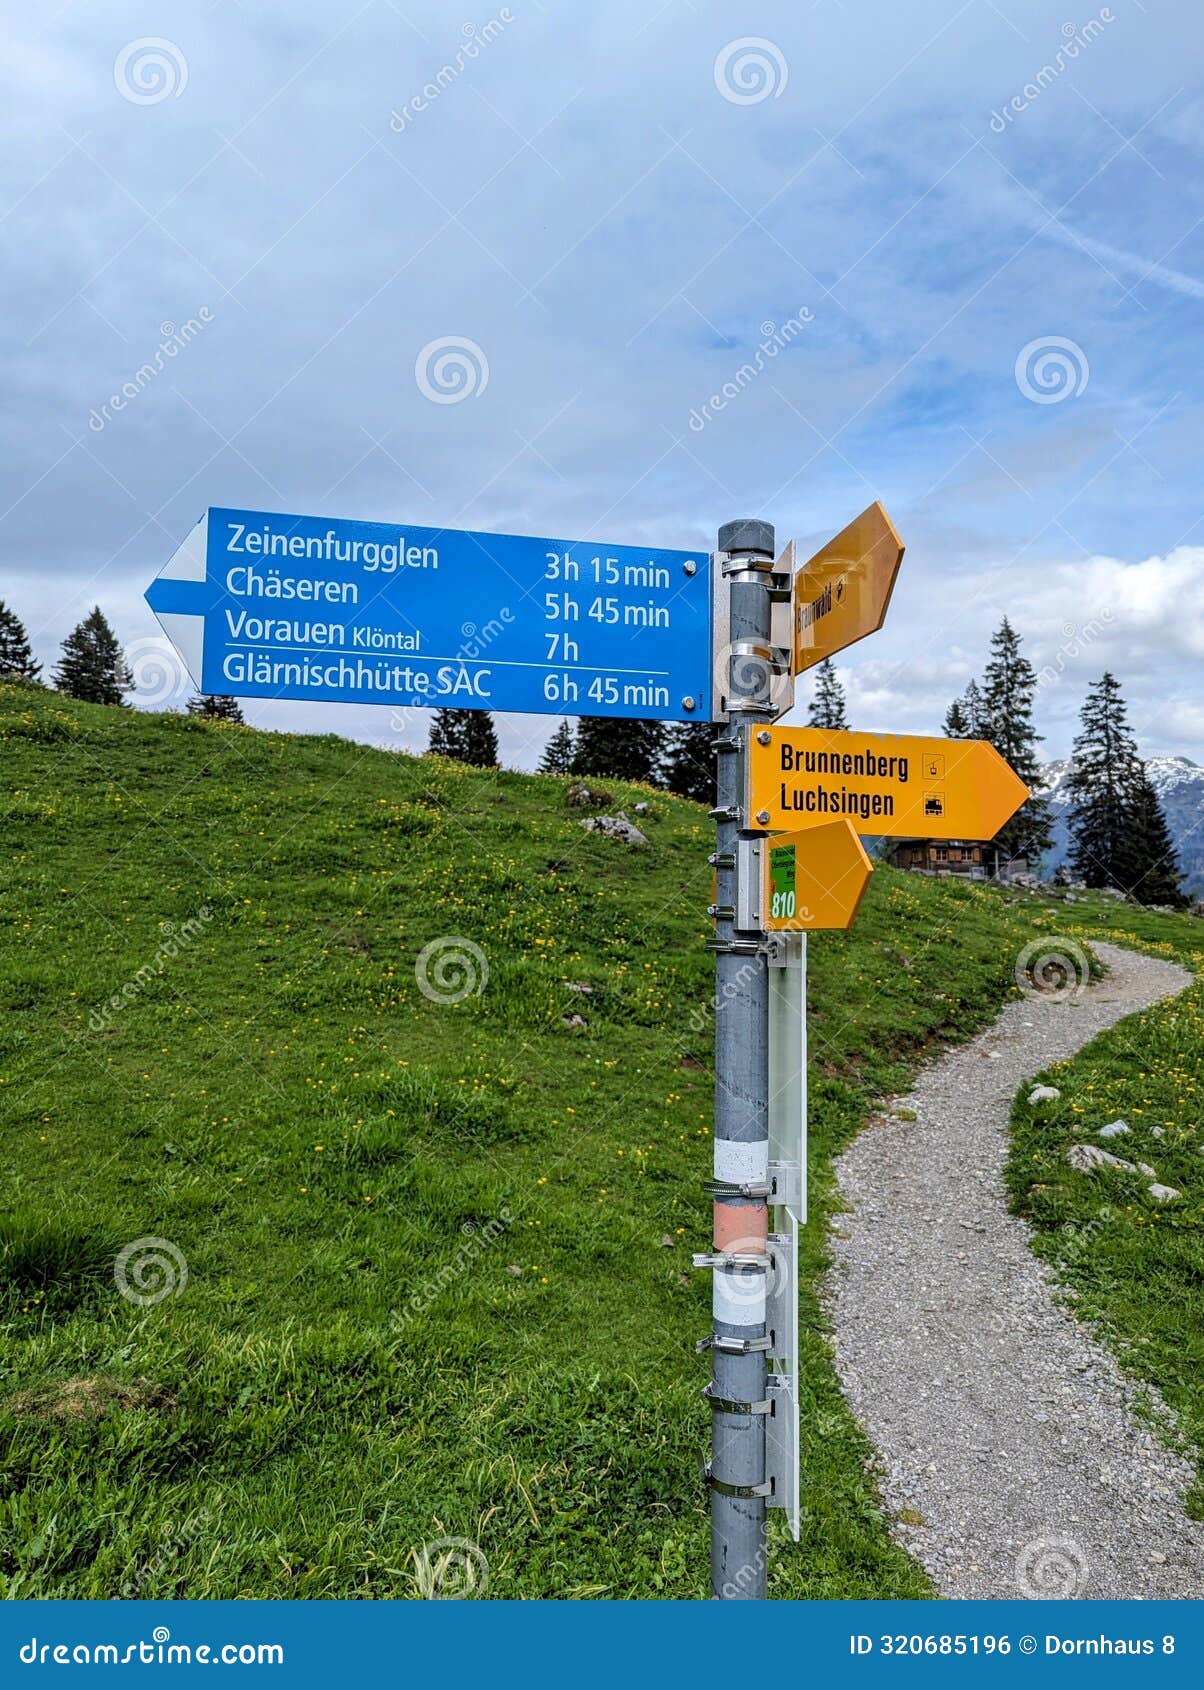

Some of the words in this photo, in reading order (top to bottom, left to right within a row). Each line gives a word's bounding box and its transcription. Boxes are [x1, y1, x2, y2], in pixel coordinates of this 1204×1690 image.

[227, 524, 438, 572] Zeinenfurgglen
[545, 552, 579, 581] 3h
[590, 557, 670, 588] 15min
[226, 566, 358, 604] Chäseren
[545, 593, 579, 621] 5h
[588, 597, 670, 628] 45min
[225, 609, 345, 646] Vorauen
[352, 626, 420, 651] Klöntal
[545, 633, 579, 661] 7h
[223, 653, 430, 694] Glärnischhütte
[437, 666, 492, 697] SAC
[544, 673, 579, 702] 6h
[587, 677, 670, 707] 45min
[781, 743, 908, 783] Brunnenberg
[781, 783, 894, 820] Luchsingen
[771, 890, 796, 919] 810
